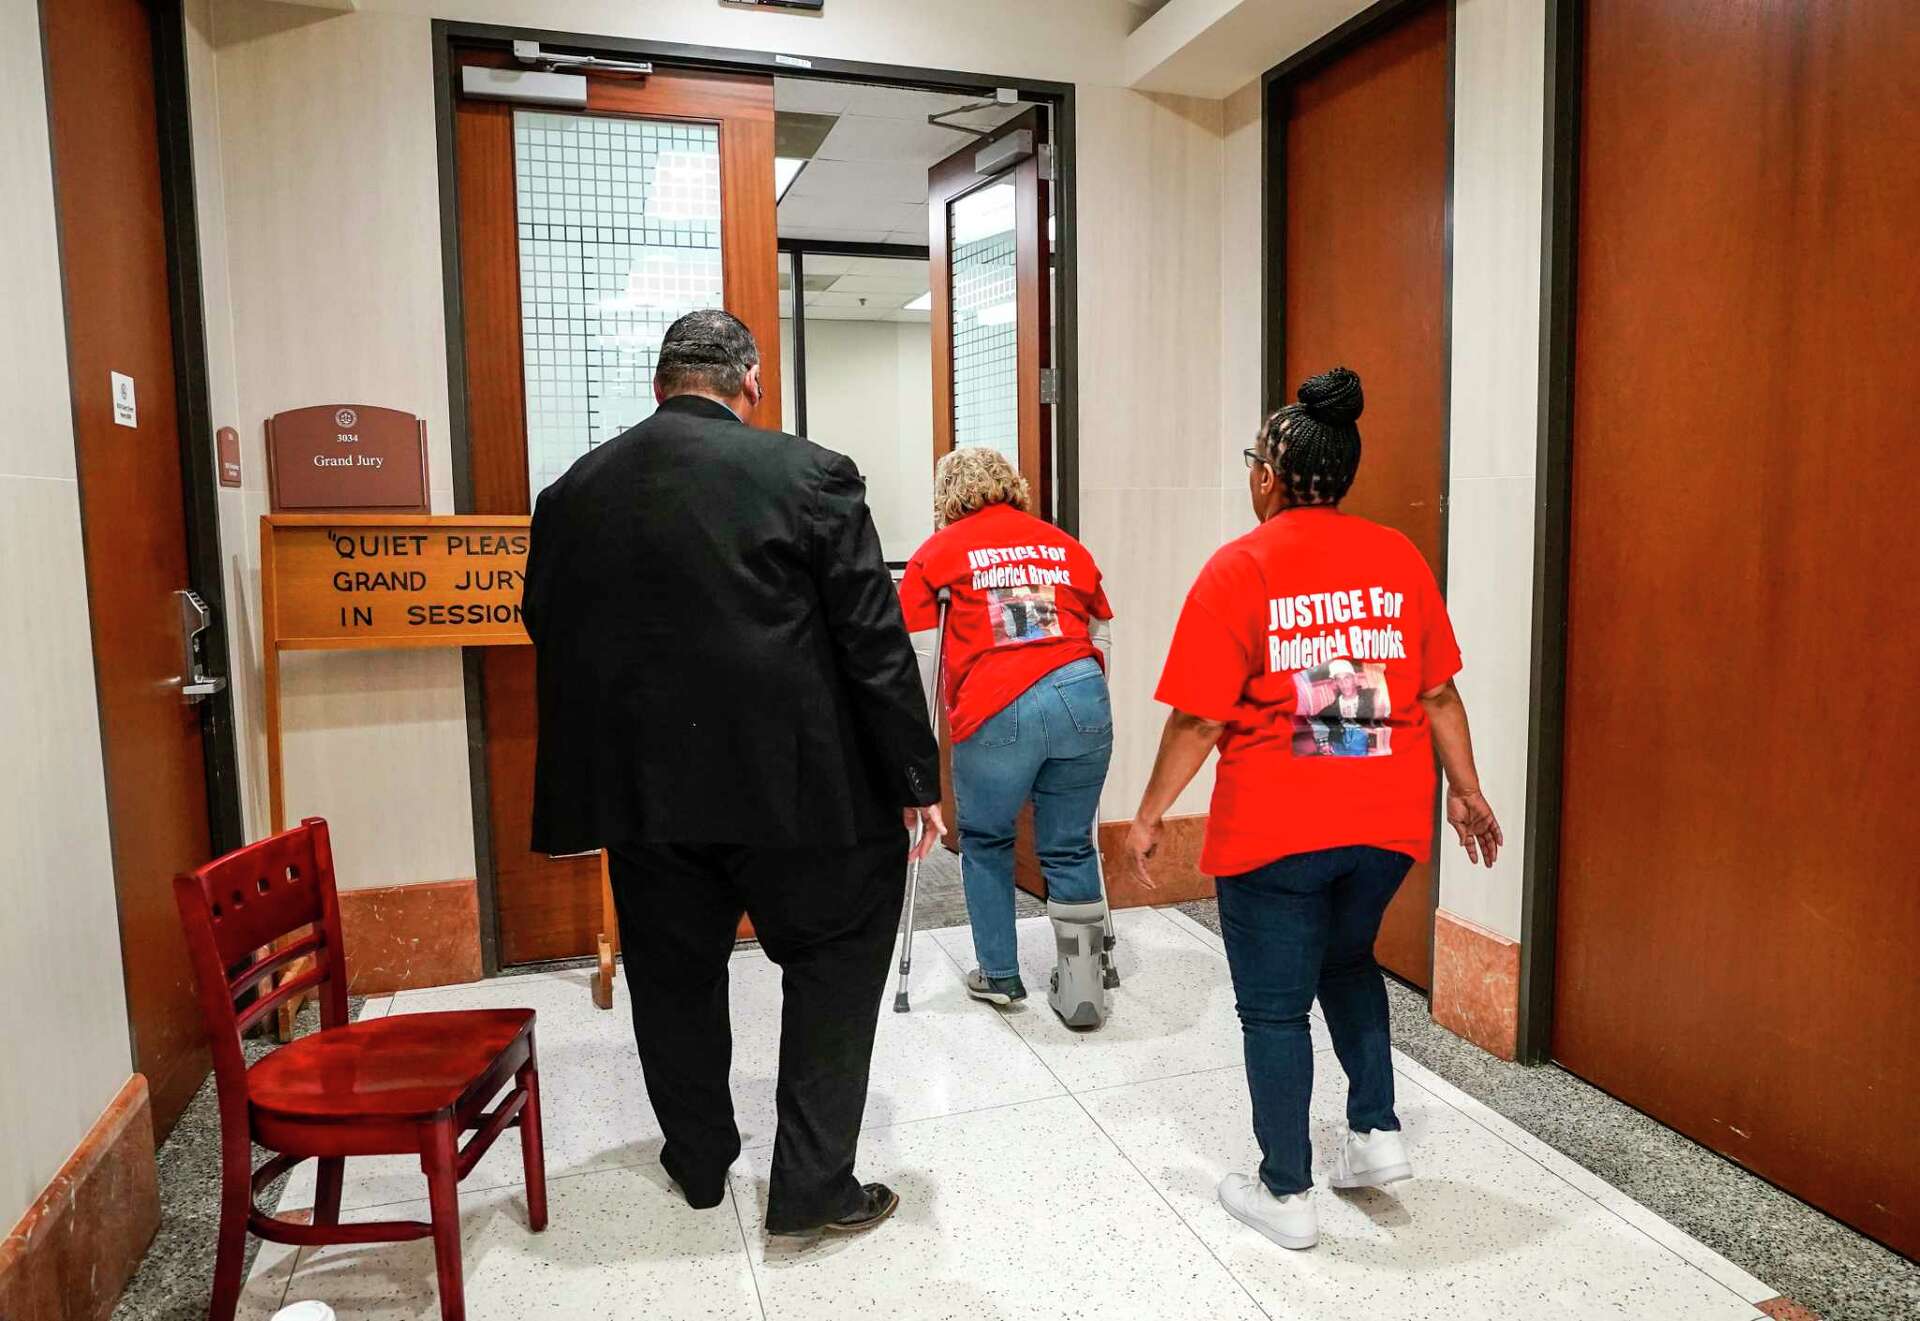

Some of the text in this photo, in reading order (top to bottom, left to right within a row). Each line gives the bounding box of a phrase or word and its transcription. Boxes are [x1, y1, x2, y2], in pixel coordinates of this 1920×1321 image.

[336, 434, 359, 442] 3034
[313, 454, 384, 469] Grand Jury
[447, 535, 528, 556] PLEAS
[967, 544, 1067, 569] JUSTICE For
[333, 571, 427, 592] GRAND
[972, 563, 1073, 591] Roderick Brooks
[341, 606, 373, 627] IN
[1268, 586, 1404, 631] JUSTICE For
[1267, 623, 1407, 673] Roderick Brooks
